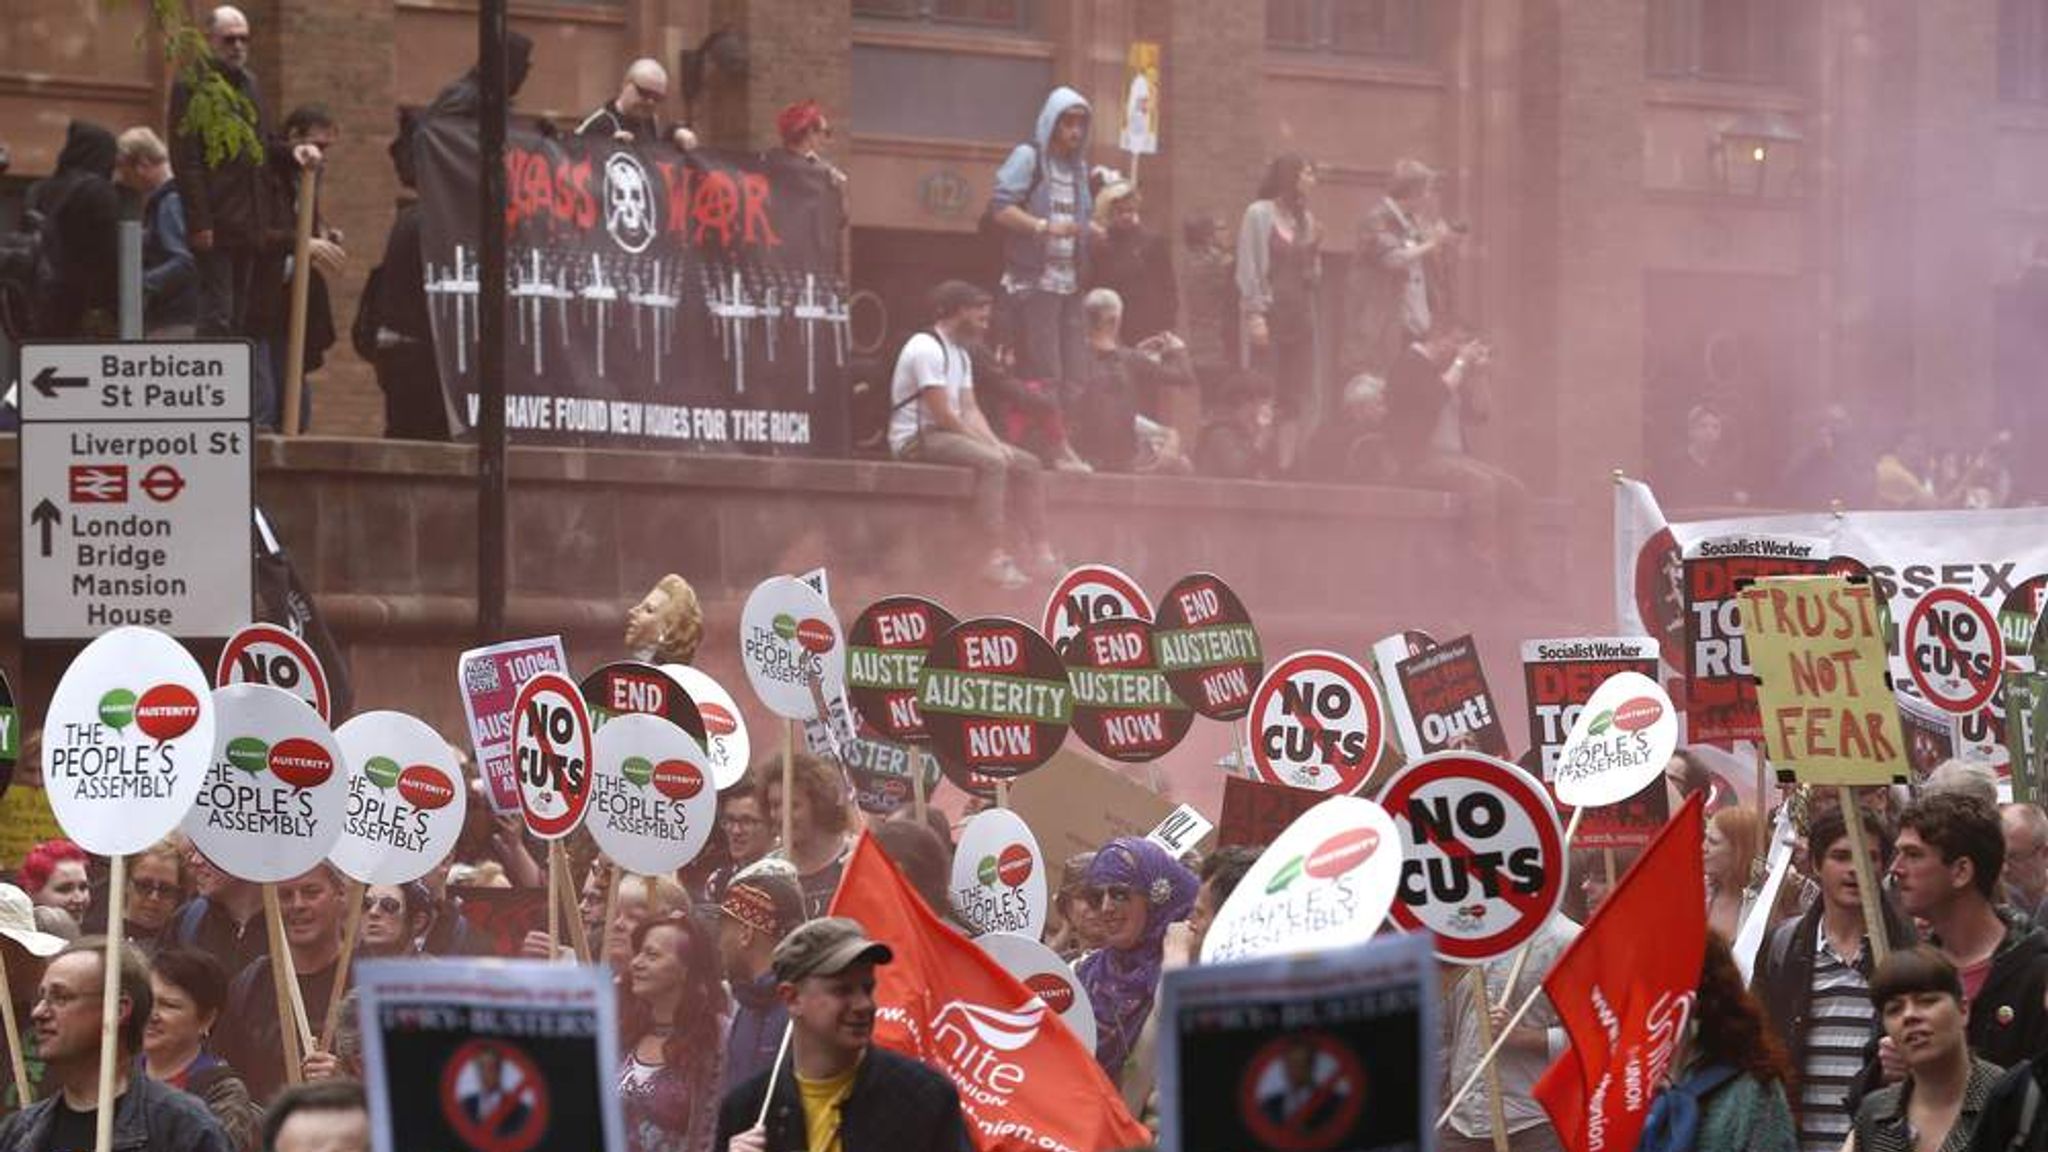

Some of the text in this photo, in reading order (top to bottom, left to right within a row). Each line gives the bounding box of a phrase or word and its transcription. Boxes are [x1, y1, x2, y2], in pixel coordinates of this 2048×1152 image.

[102, 355, 223, 377] Barbican
[102, 383, 225, 407] St Paul's
[505, 395, 550, 429] HAVE
[555, 397, 607, 432] FOUND
[611, 401, 643, 435] NEW
[644, 403, 691, 438] HOMES
[692, 407, 727, 441] FOR
[730, 410, 768, 441] THE
[769, 411, 810, 443] RICH
[70, 432, 240, 459] Liverpool St
[72, 514, 171, 537] London
[78, 544, 166, 570] Bridge
[73, 573, 186, 595] Mansion
[1870, 563, 2016, 601] SSEX
[88, 603, 172, 626] House
[1067, 593, 1123, 629] NO
[1179, 587, 1219, 625] END
[1692, 599, 1745, 640] TO
[1742, 586, 1873, 640] TRUST
[753, 626, 778, 647] THE
[877, 611, 926, 645] END
[1926, 608, 1978, 643] NO
[964, 635, 1018, 669] END
[1094, 632, 1142, 667] END
[1162, 628, 1258, 668] AUSTERITY
[1915, 643, 1991, 682] CUTS
[241, 652, 299, 689] NO
[505, 651, 559, 684] 100%
[851, 651, 926, 686] AUSTE
[1789, 649, 1862, 697] NOT
[613, 677, 663, 713] END
[924, 673, 1065, 719] AUSTERITY
[1203, 667, 1250, 707] NOW
[1281, 680, 1352, 720] NO
[137, 706, 198, 717] AUSTERITY
[528, 700, 574, 745] NO
[1105, 711, 1164, 747] NOW
[1421, 694, 1492, 745] Out!
[65, 723, 104, 746] THE
[968, 724, 1032, 758] NOW
[1264, 725, 1367, 768] CUTS
[1776, 706, 1897, 762] FEAR
[51, 744, 175, 778] PEOPLE'S
[205, 762, 235, 783] HE
[271, 755, 330, 770] AUSTERITY
[518, 745, 584, 795] CUTS
[73, 775, 178, 800] ASSEMBLY
[196, 783, 313, 818] EOPLE'S
[595, 772, 627, 794] THE
[208, 808, 319, 838] ASSEMBLY
[346, 792, 431, 835] OPLE'S
[606, 815, 690, 841] ASSEMBLY
[1408, 791, 1506, 844] NO
[343, 817, 431, 853] SSEMBLY
[1400, 846, 1546, 906] CUTS
